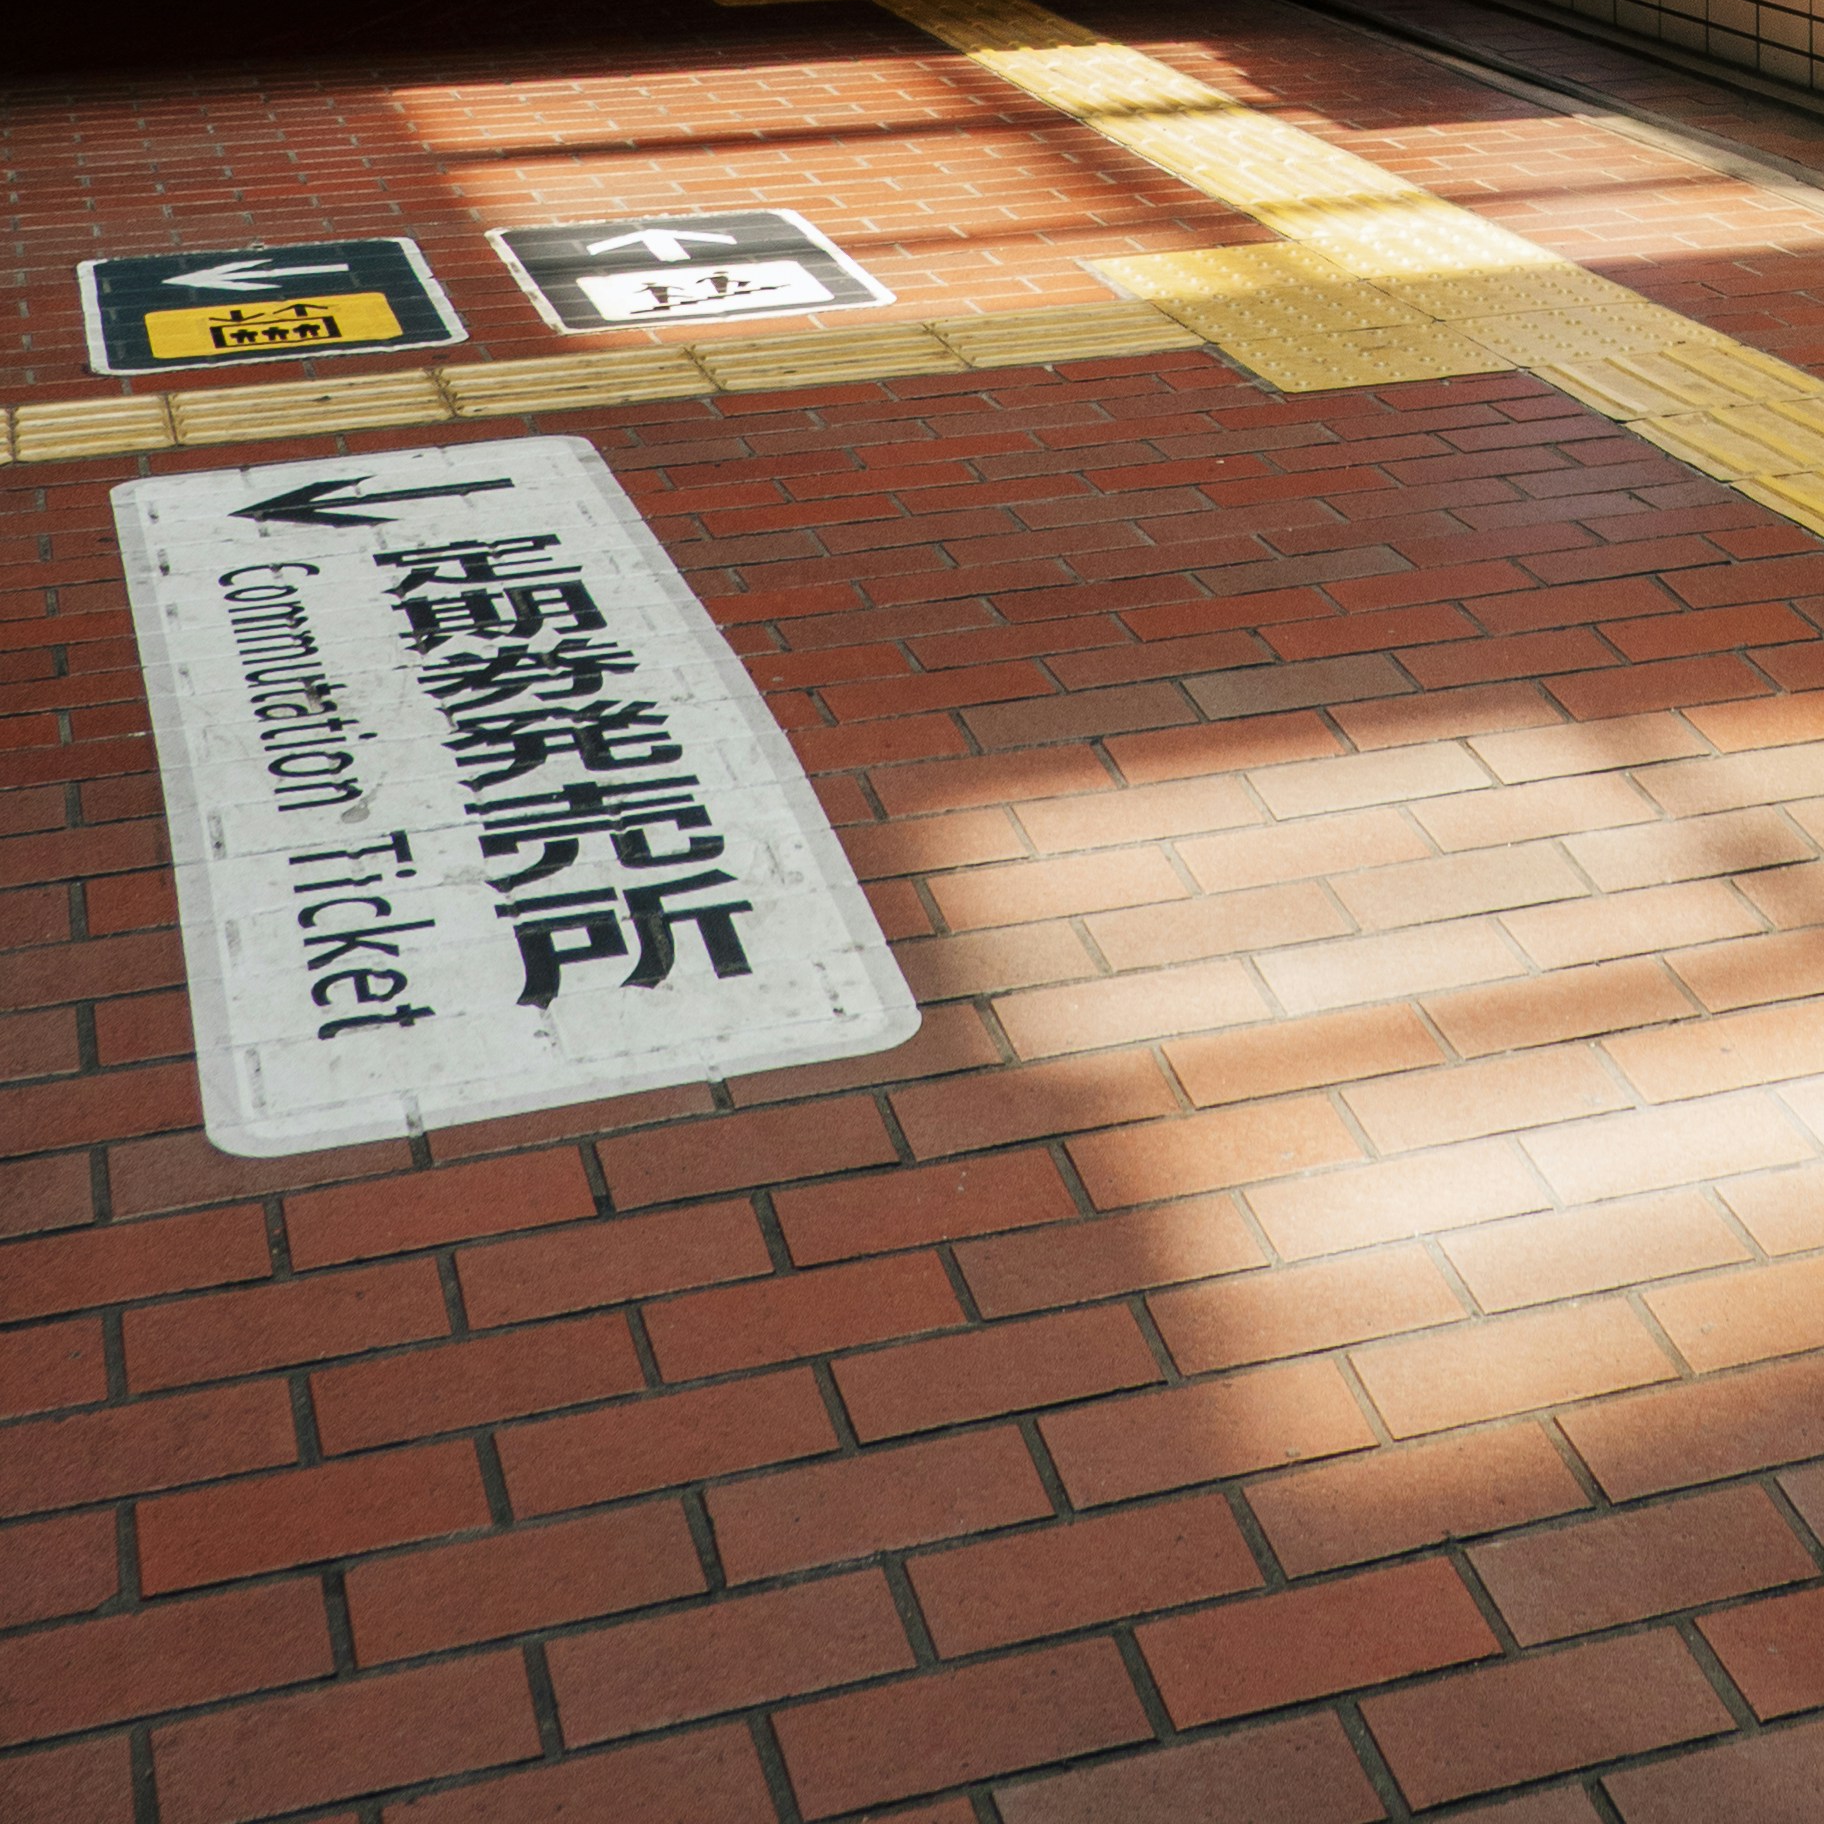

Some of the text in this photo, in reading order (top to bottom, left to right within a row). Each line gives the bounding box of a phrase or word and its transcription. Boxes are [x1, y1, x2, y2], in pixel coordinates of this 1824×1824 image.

[217, 561, 436, 1041] Commutation Ticket
[372, 532, 754, 1010] 定期券発売所
